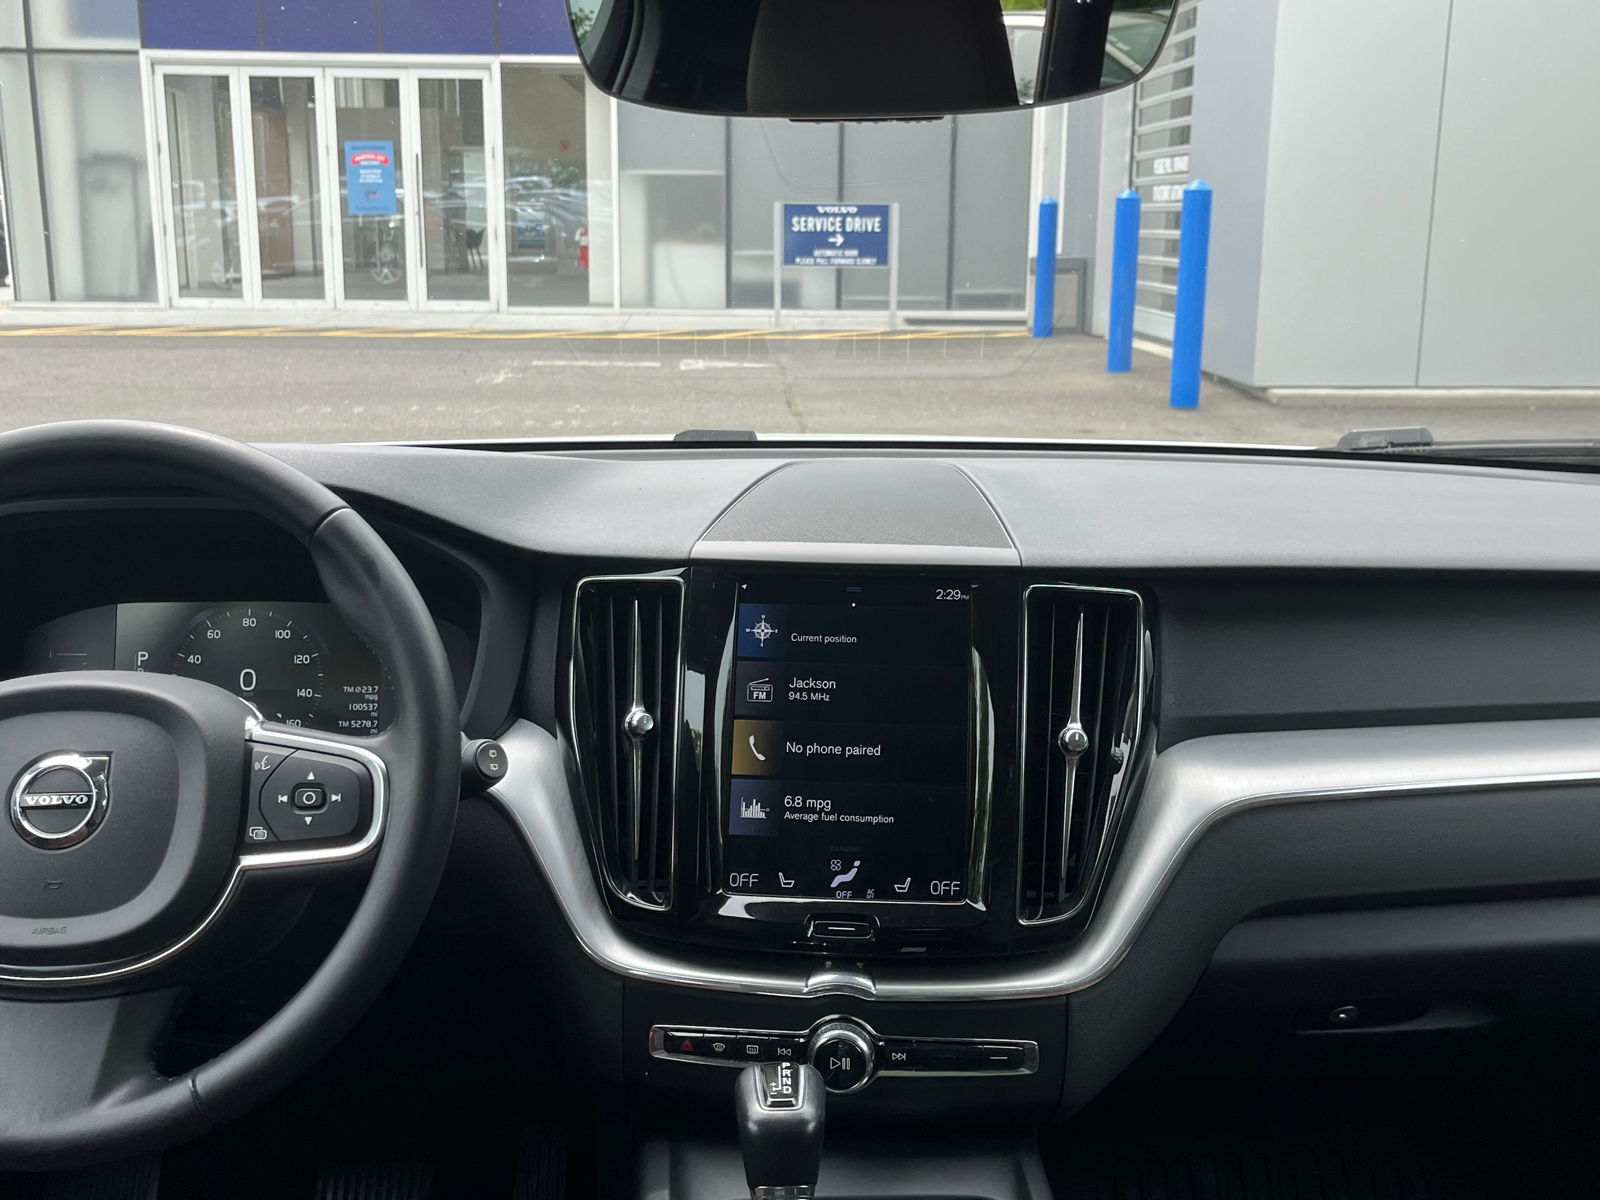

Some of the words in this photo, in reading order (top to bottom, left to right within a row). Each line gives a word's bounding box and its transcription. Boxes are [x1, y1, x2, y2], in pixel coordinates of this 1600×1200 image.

[816, 206, 858, 214] VOLVO
[791, 217, 843, 232] SERVICE
[845, 217, 882, 232] DRIVE
[813, 249, 843, 257] AUTOMATIC
[795, 257, 815, 265] PLEASE
[936, 588, 961, 600] 2:29
[242, 618, 257, 627] 80
[207, 629, 221, 639] 60
[275, 630, 291, 639] 100
[791, 633, 822, 642] Current
[824, 634, 857, 644] position
[137, 651, 149, 666] P
[187, 655, 202, 664] 40
[294, 655, 310, 664] 120
[239, 668, 257, 691] 0
[789, 677, 836, 689] Jackson
[297, 688, 313, 697] 140
[753, 691, 766, 700] FM
[788, 691, 808, 701] 94.5
[810, 692, 830, 702] MHz
[349, 703, 378, 711] 100537
[286, 719, 302, 727] 160
[351, 720, 378, 728] 5278.7
[786, 741, 803, 753] No
[806, 742, 842, 757] phone
[845, 744, 881, 758] paired
[24, 795, 88, 805] VOLVO
[784, 795, 803, 808] 6.8
[806, 799, 832, 812] mpg
[783, 811, 819, 823] Average
[821, 812, 838, 822] fuel
[839, 814, 895, 826] consumption
[729, 872, 759, 888] OFF
[930, 880, 961, 896] OFF
[836, 890, 853, 899] OFF
[31, 926, 68, 935] AIRBAG
